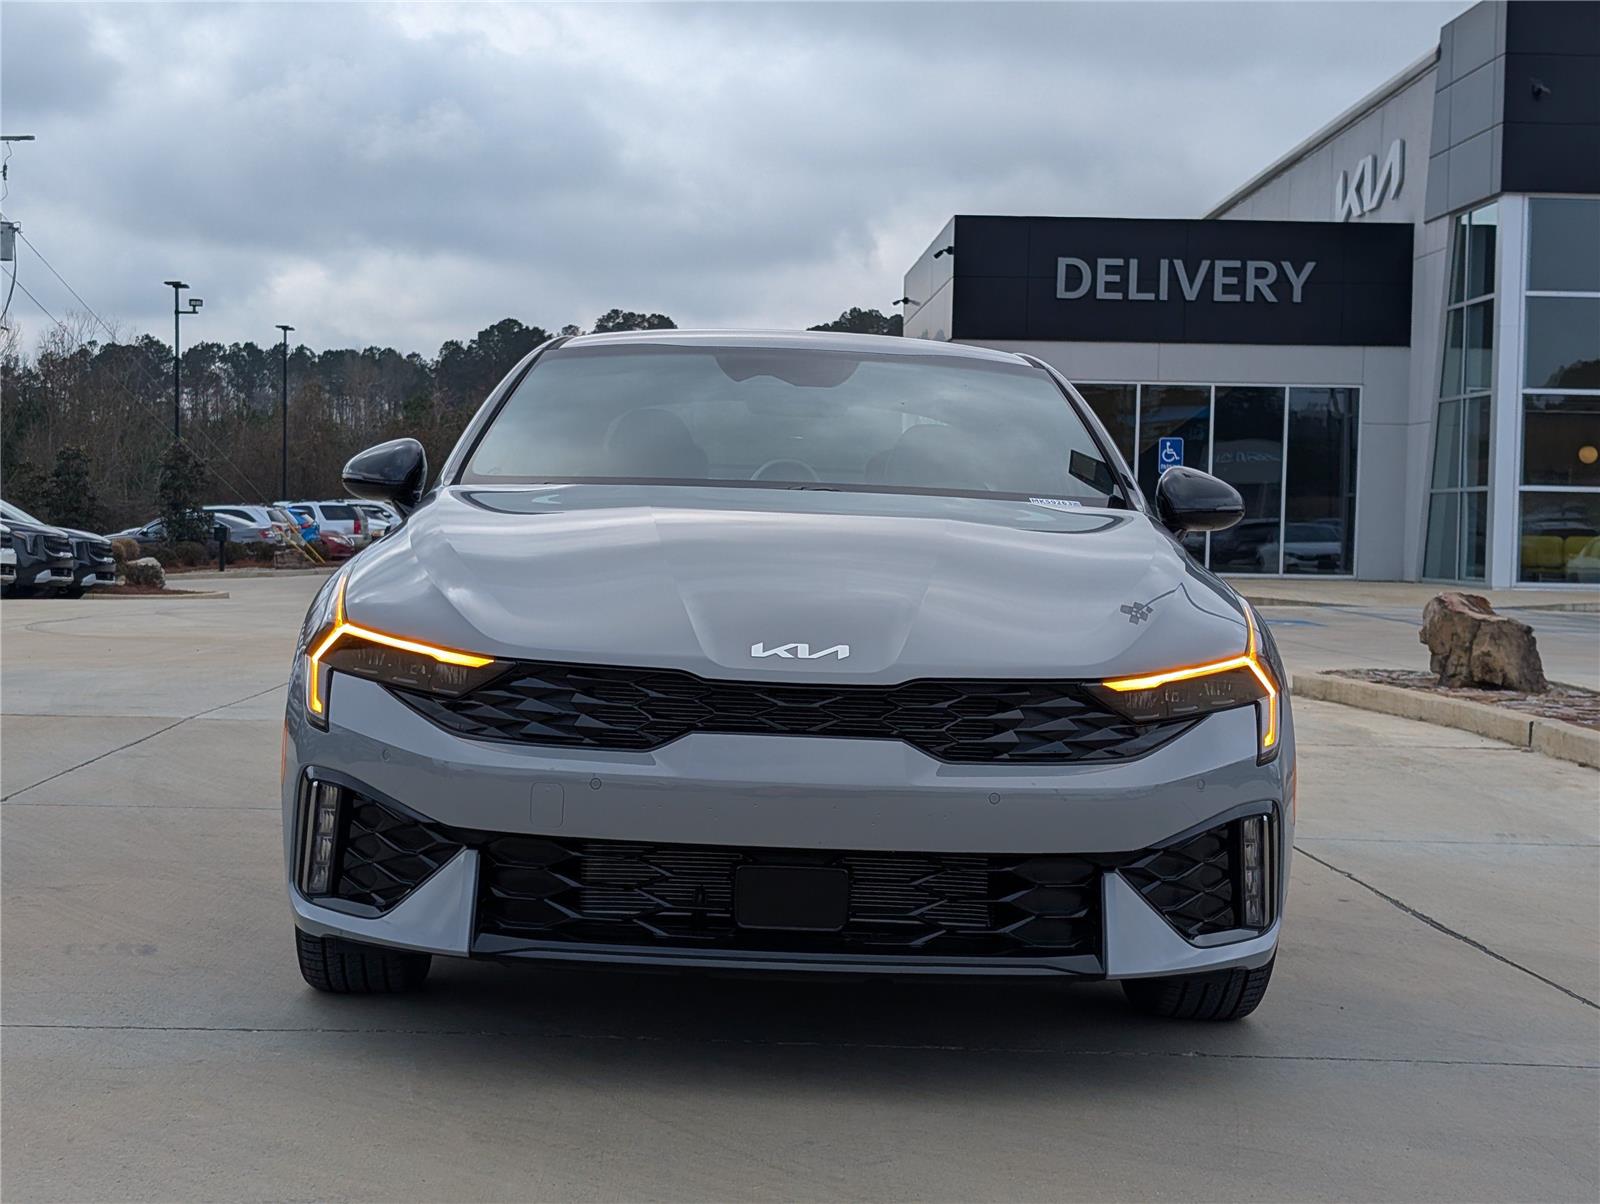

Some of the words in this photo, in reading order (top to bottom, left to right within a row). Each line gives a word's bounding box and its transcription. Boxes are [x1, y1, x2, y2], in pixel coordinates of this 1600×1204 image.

[1335, 139, 1406, 223] KIA
[1056, 257, 1316, 303] DELIVERY
[751, 642, 850, 660] KIA
